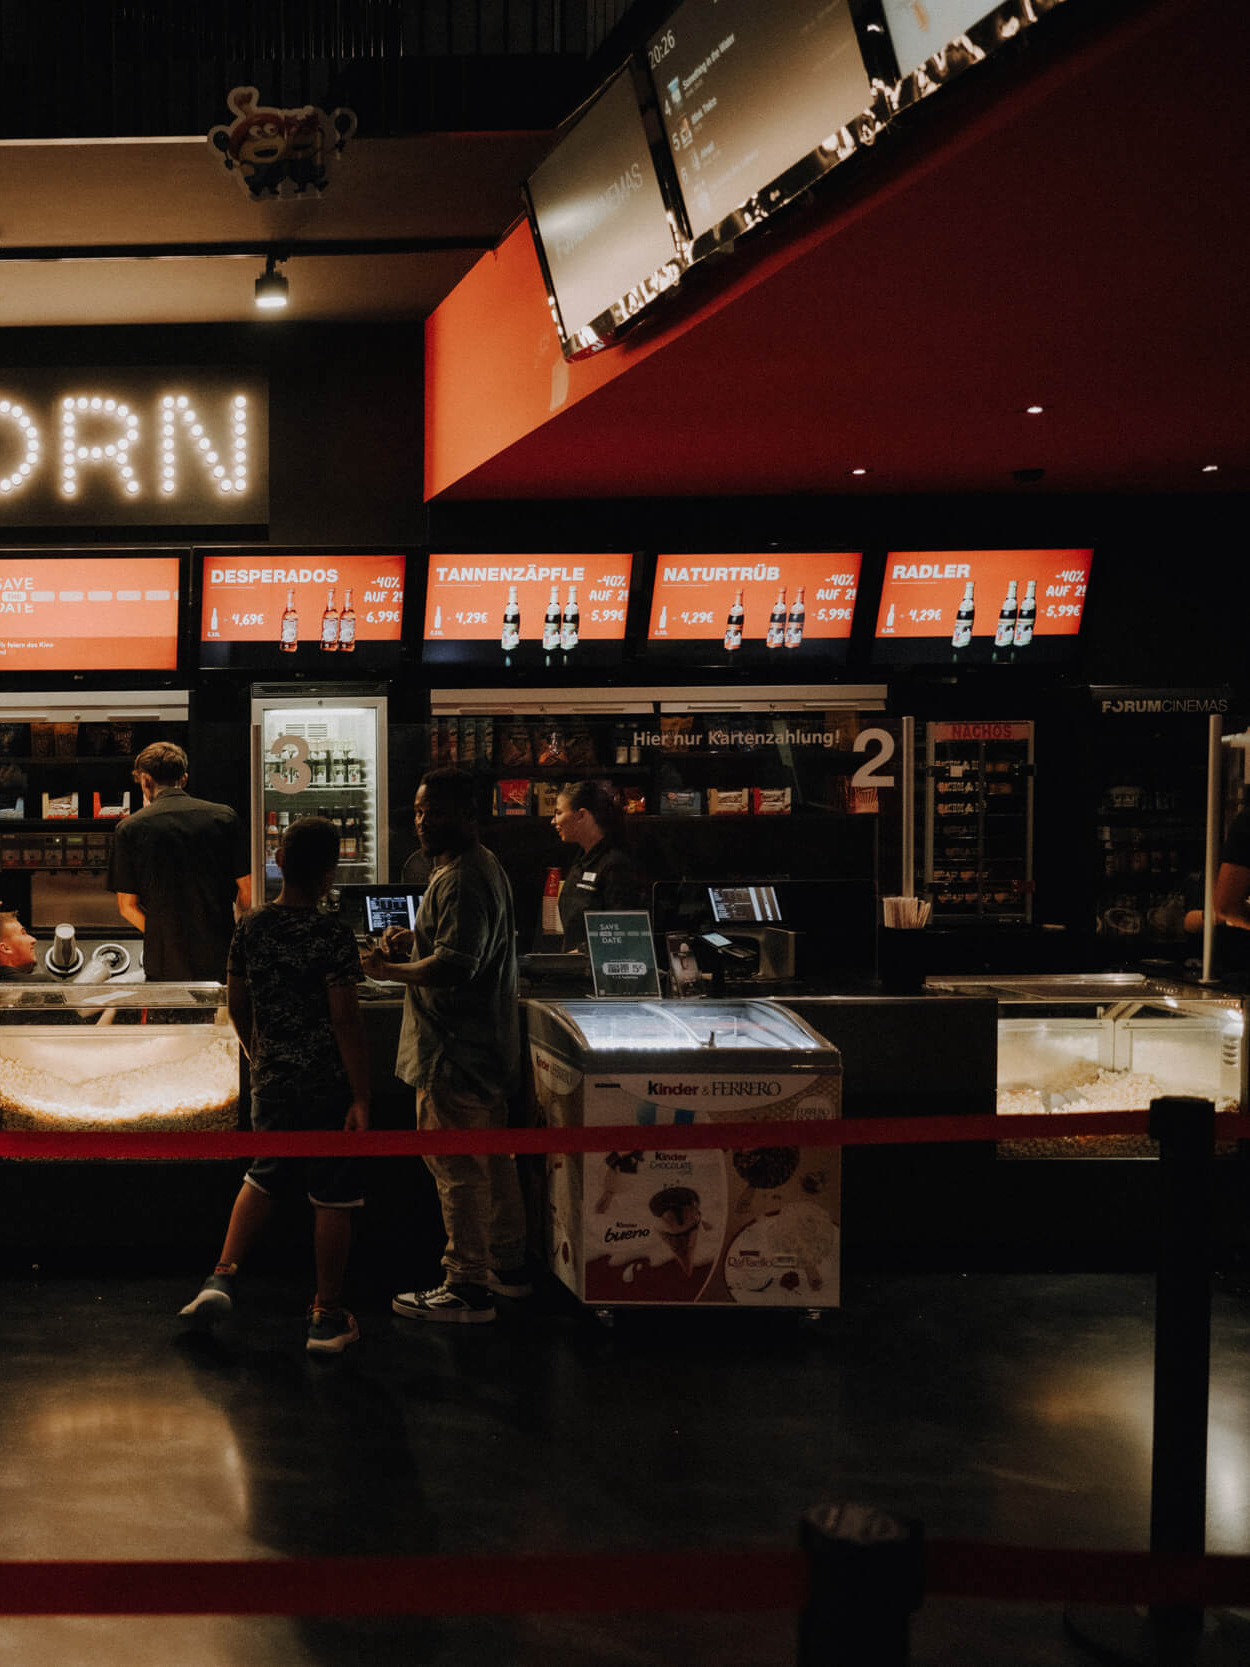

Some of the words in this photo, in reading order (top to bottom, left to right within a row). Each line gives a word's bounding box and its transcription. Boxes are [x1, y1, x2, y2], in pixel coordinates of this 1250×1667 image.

[648, 29, 675, 70] 20:26
[672, 132, 680, 151] 5
[211, 569, 338, 583] DESPERADOS
[436, 564, 585, 582] TANNENZÄPFLE
[663, 563, 780, 582] NATURTRÜB
[892, 563, 970, 579] RADLER
[1055, 570, 1084, 583] -40%
[371, 576, 400, 588] -40%
[597, 575, 626, 587] -40%
[824, 573, 854, 586] -40%
[364, 591, 388, 603] AUF
[588, 589, 612, 602] AUF
[816, 588, 841, 601] AUF
[1045, 585, 1071, 597] AUF
[952, 725, 1012, 738] NACHOS
[633, 731, 669, 746] Hier
[673, 733, 703, 746] nur
[707, 730, 841, 748] Kartenzahlung!
[851, 727, 896, 787] 2
[269, 735, 311, 794] 3
[598, 923, 620, 931] SAVE
[601, 936, 623, 944] DATE
[648, 1081, 700, 1096] Kinder
[711, 1081, 782, 1097] FERRERO
[655, 1152, 687, 1161] Kinder
[605, 1227, 650, 1243] bueno
